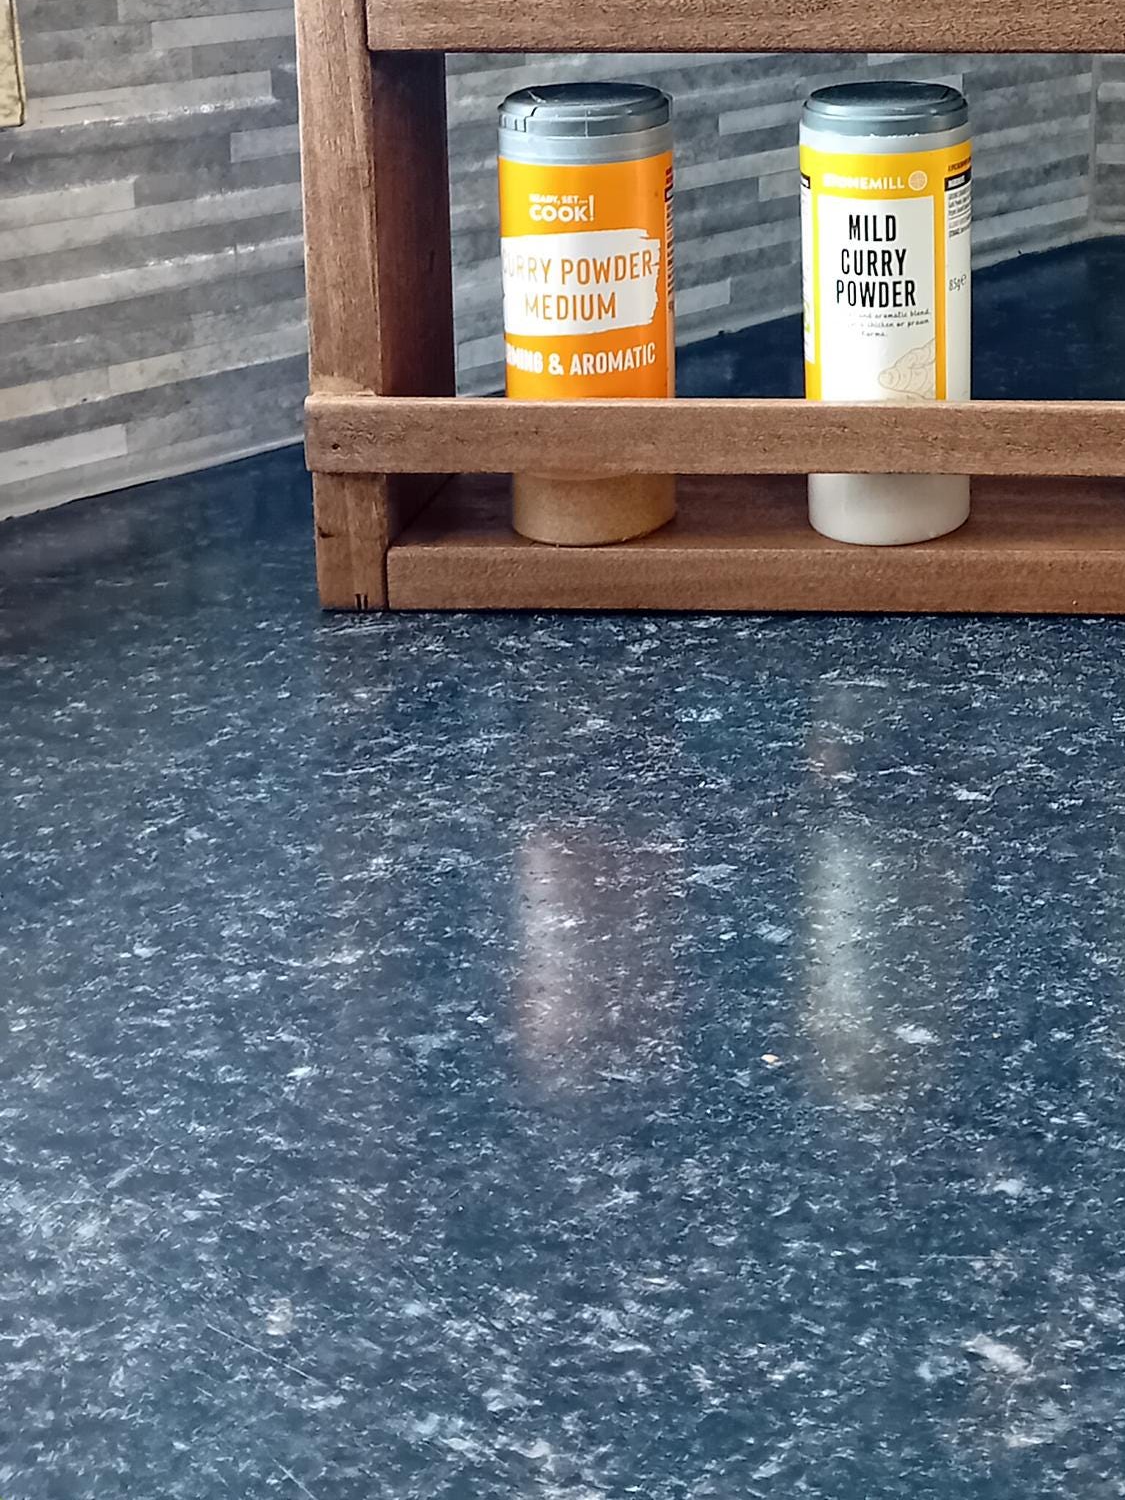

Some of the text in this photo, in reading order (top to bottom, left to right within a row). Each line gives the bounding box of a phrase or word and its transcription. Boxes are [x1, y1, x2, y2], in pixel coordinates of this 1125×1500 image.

[528, 195, 595, 222] COOK!
[848, 214, 897, 242] MILD
[561, 249, 653, 285] POWDER
[841, 248, 907, 277] CURRY
[524, 291, 618, 322] MEDIUM
[836, 279, 917, 308] POWDER
[548, 352, 564, 376] &
[569, 342, 656, 376] AROMATIC
